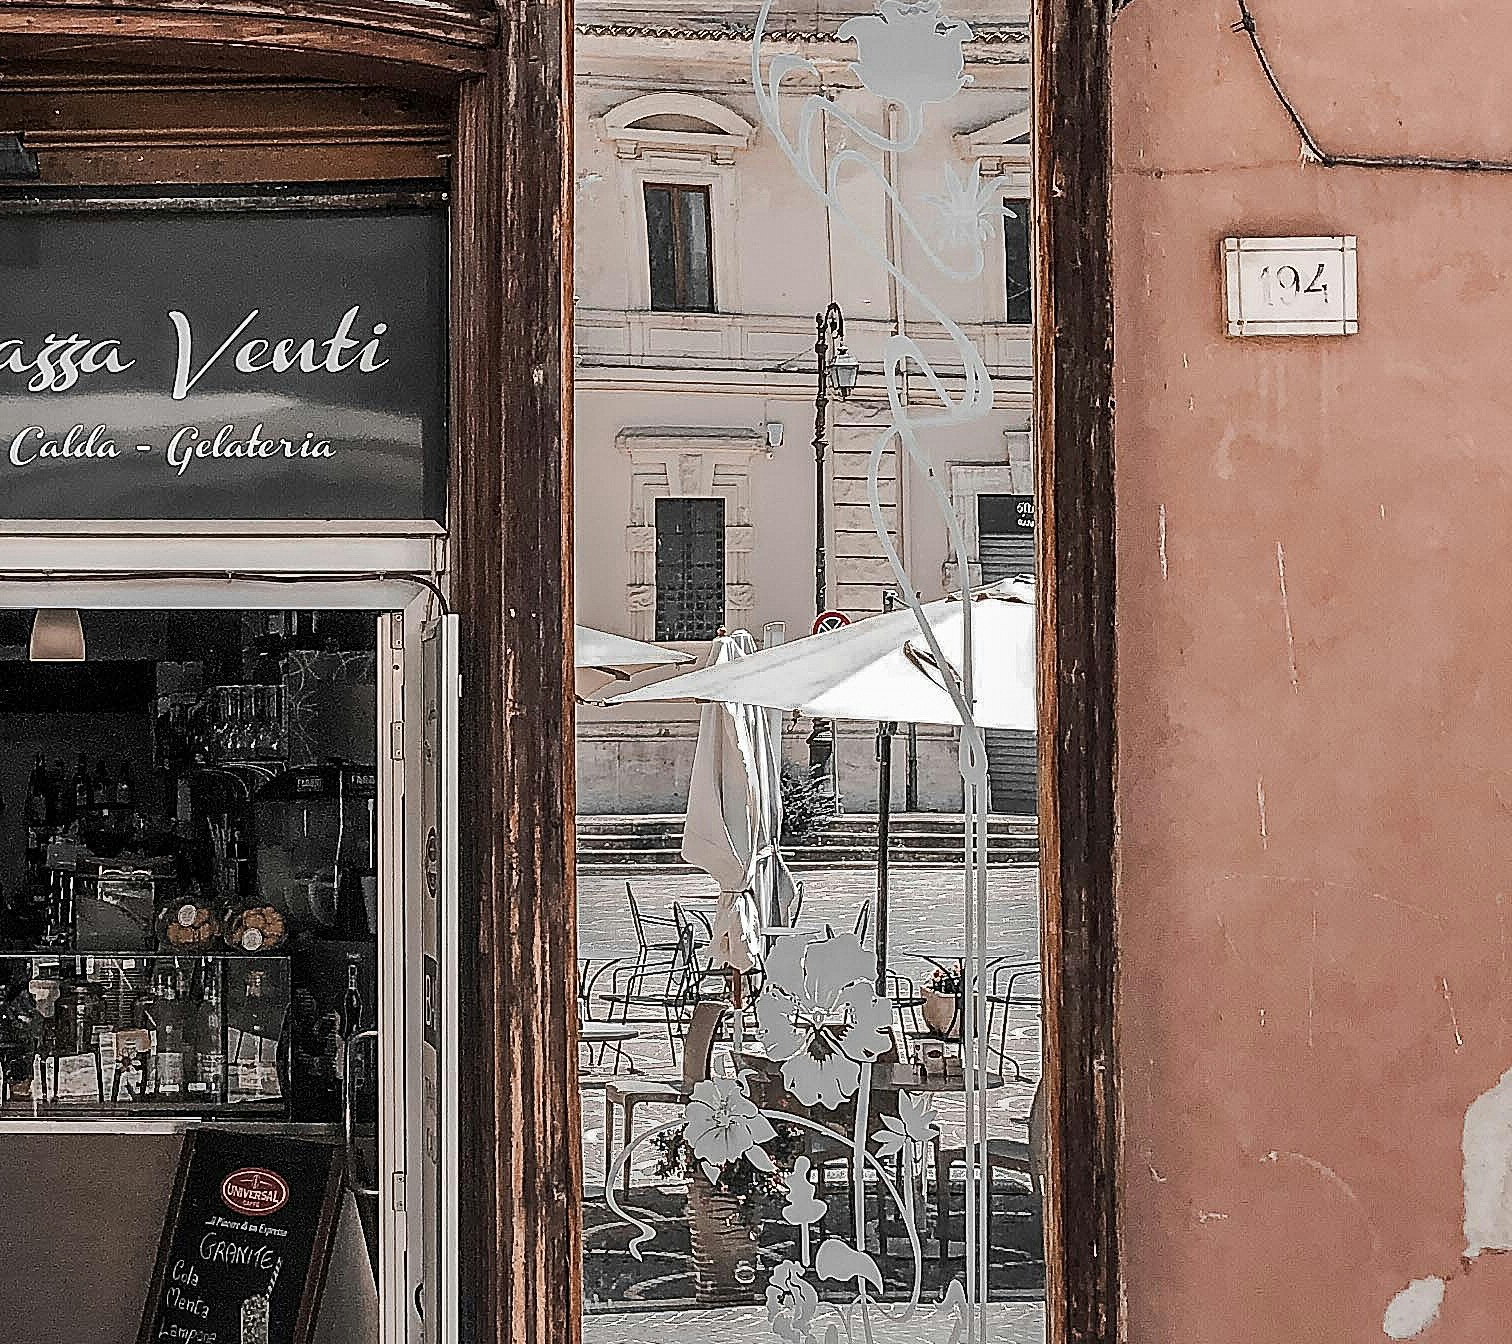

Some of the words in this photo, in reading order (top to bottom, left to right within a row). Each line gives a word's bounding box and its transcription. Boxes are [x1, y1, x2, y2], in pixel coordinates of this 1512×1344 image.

[1260, 263, 1329, 306] 194
[168, 305, 389, 400] Venti
[9, 424, 121, 466] Calda
[167, 423, 337, 476] Gelateria
[228, 1183, 280, 1203] UNIVERSAL
[200, 1232, 274, 1269] GRANITE
[173, 1259, 199, 1287] Cola
[167, 1287, 210, 1319] Menta
